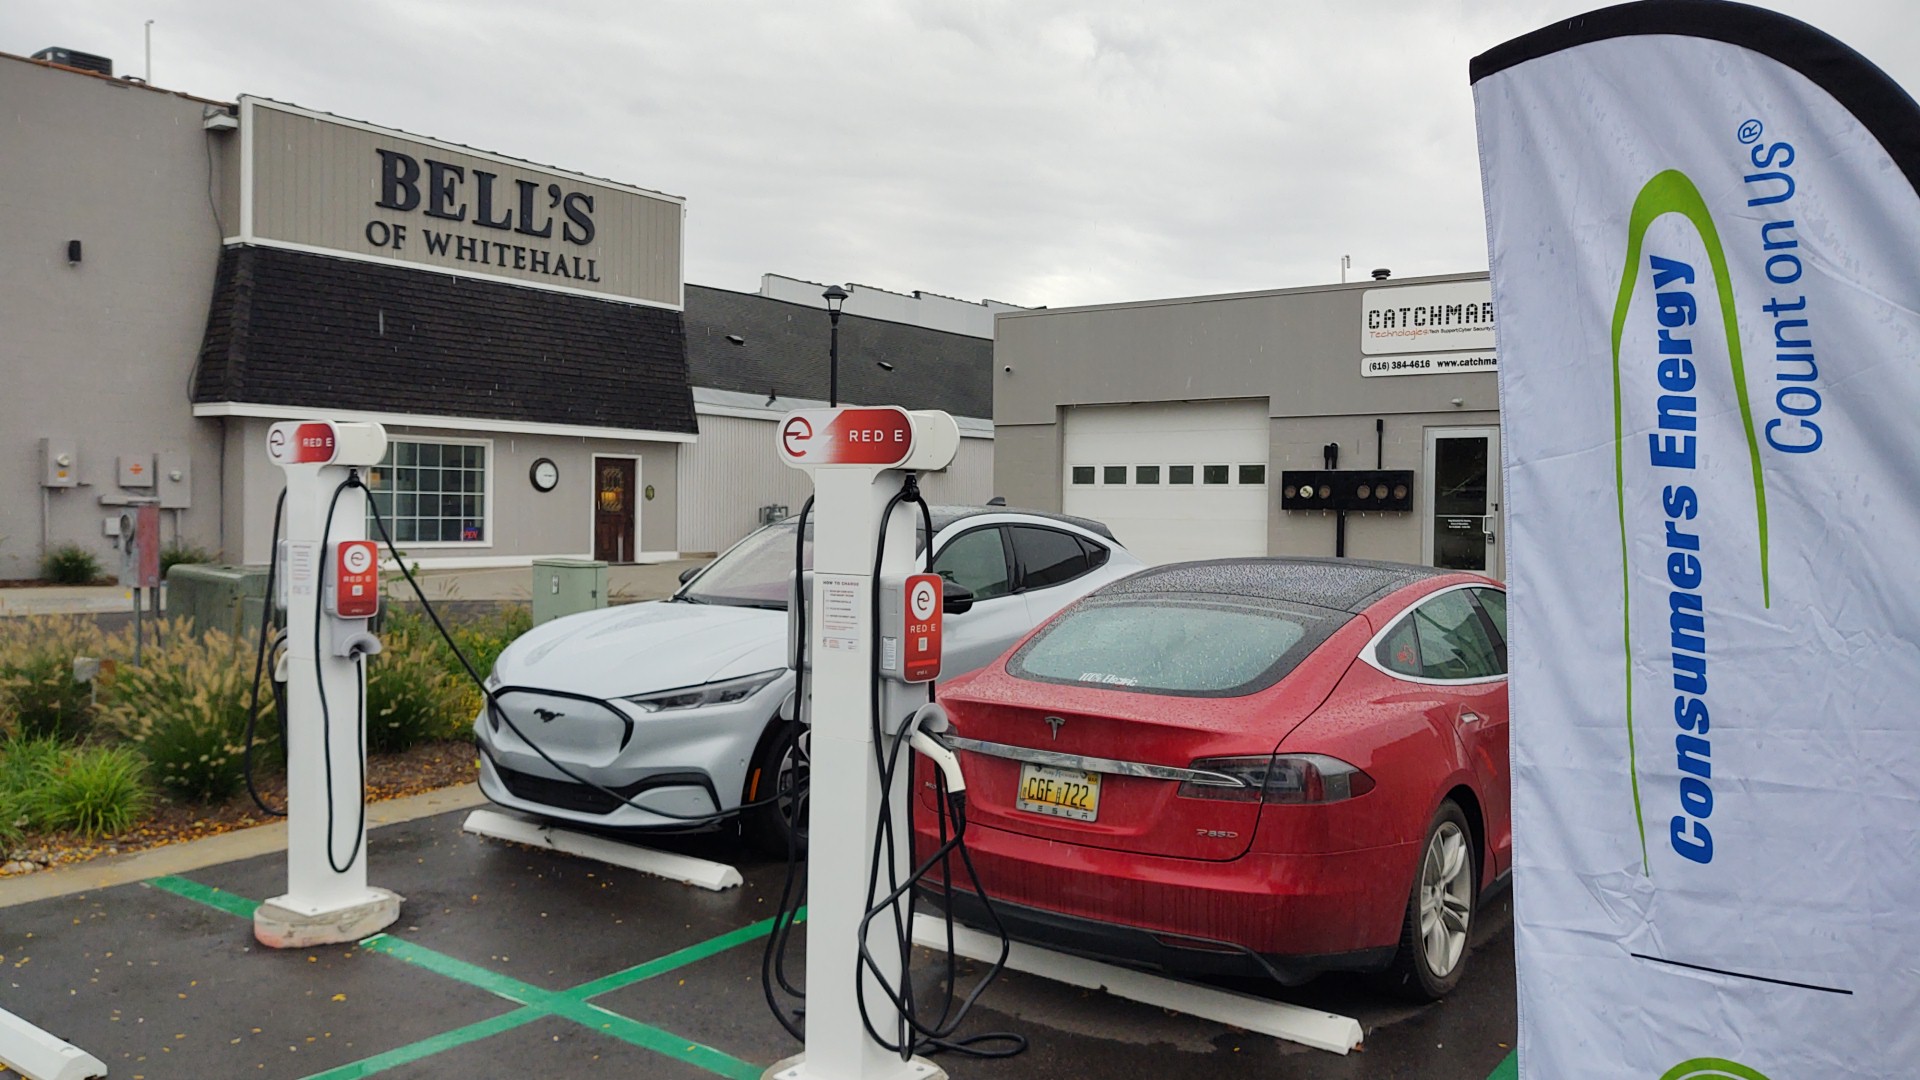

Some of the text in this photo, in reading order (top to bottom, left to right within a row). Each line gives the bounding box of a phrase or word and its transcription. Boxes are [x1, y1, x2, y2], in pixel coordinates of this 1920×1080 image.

[375, 148, 596, 246] BELL'S
[365, 220, 601, 283] OF WHITEHALL
[1762, 220, 1802, 284] on
[1368, 357, 1497, 372] (616) 384-4616 www.catchma
[1763, 296, 1822, 453] Count
[302, 437, 333, 448] RED E
[849, 429, 904, 443] RED E
[1649, 255, 1713, 864] Consumers Energy
[910, 623, 936, 634] RED E
[1027, 777, 1054, 801] CGF
[1063, 781, 1089, 808] 722
[1023, 802, 1088, 819] TESLA
